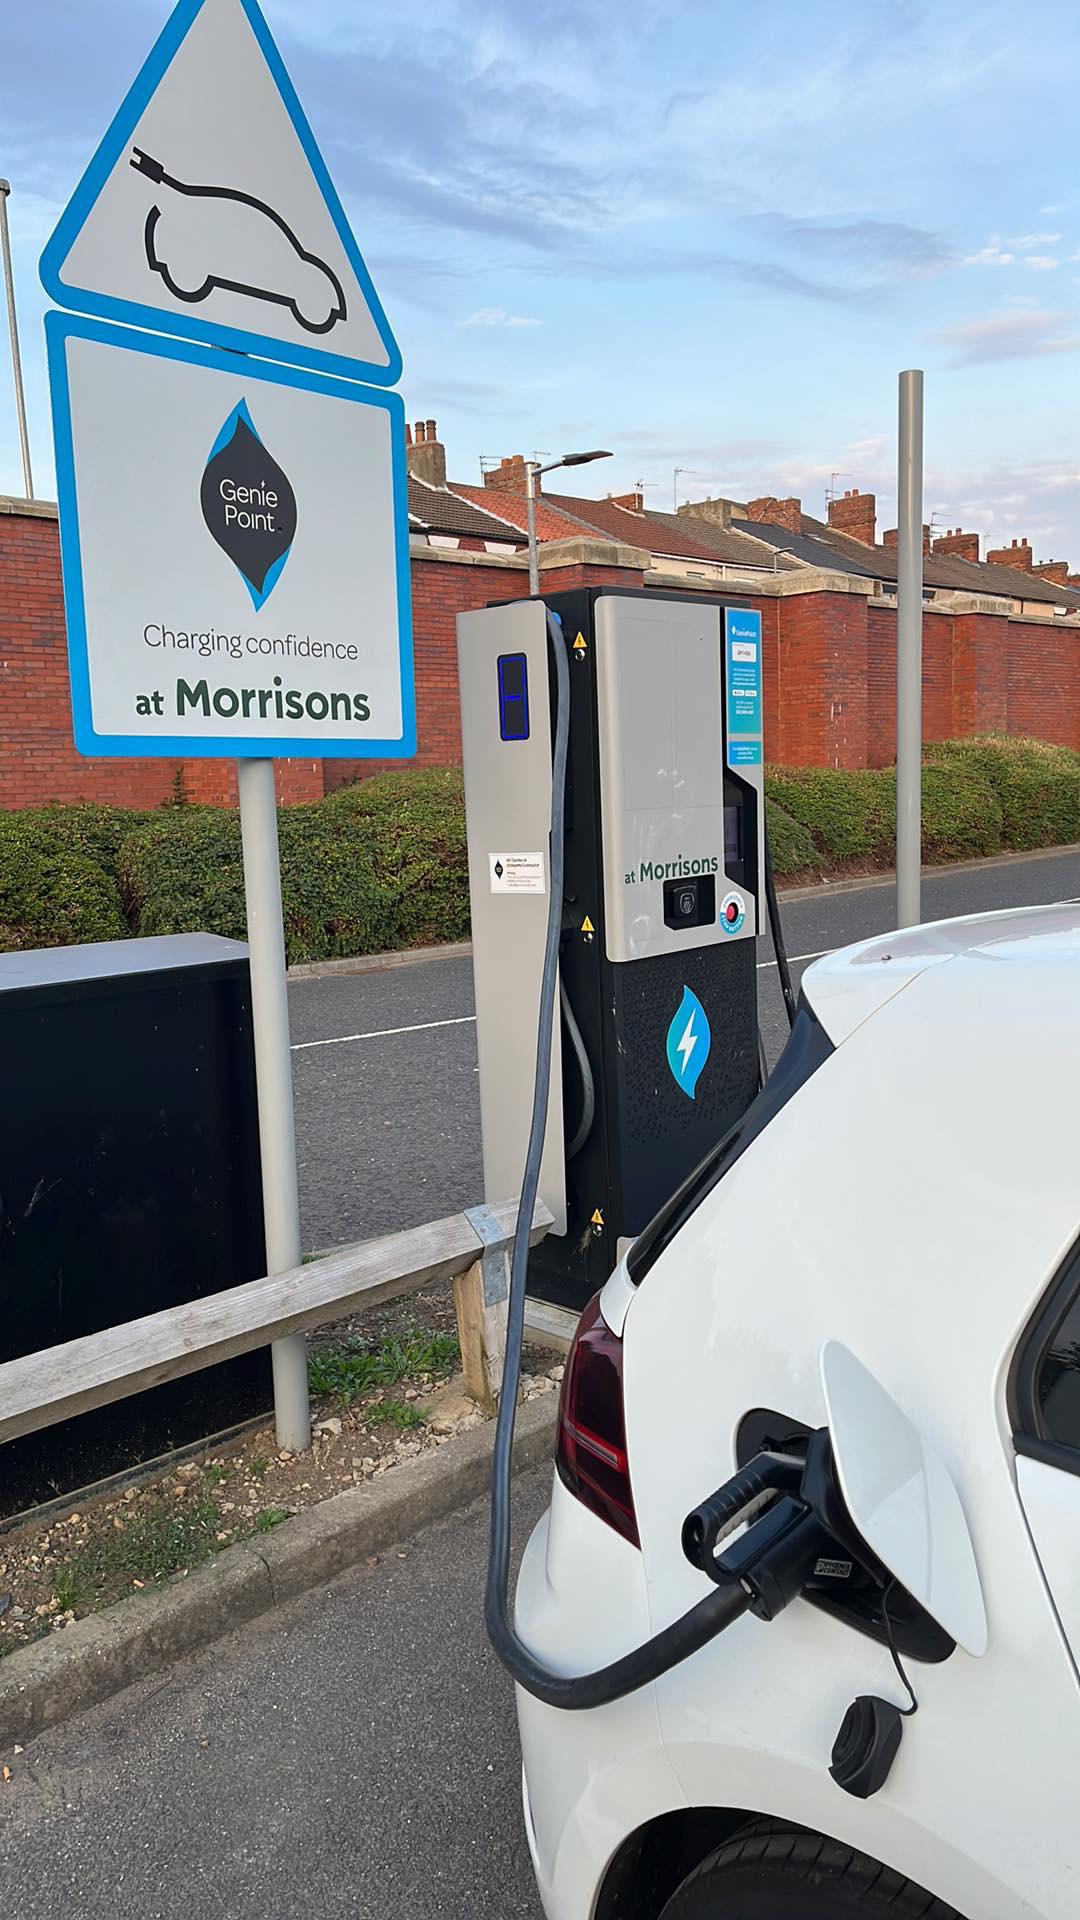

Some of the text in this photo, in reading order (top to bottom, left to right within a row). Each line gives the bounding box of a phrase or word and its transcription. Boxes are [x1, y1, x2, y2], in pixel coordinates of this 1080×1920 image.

[219, 479, 278, 508] Genie
[224, 504, 276, 533] Point
[143, 624, 359, 660] Charging confidence
[135, 676, 371, 722] at Morrisons
[624, 854, 719, 885] at Morrisons
